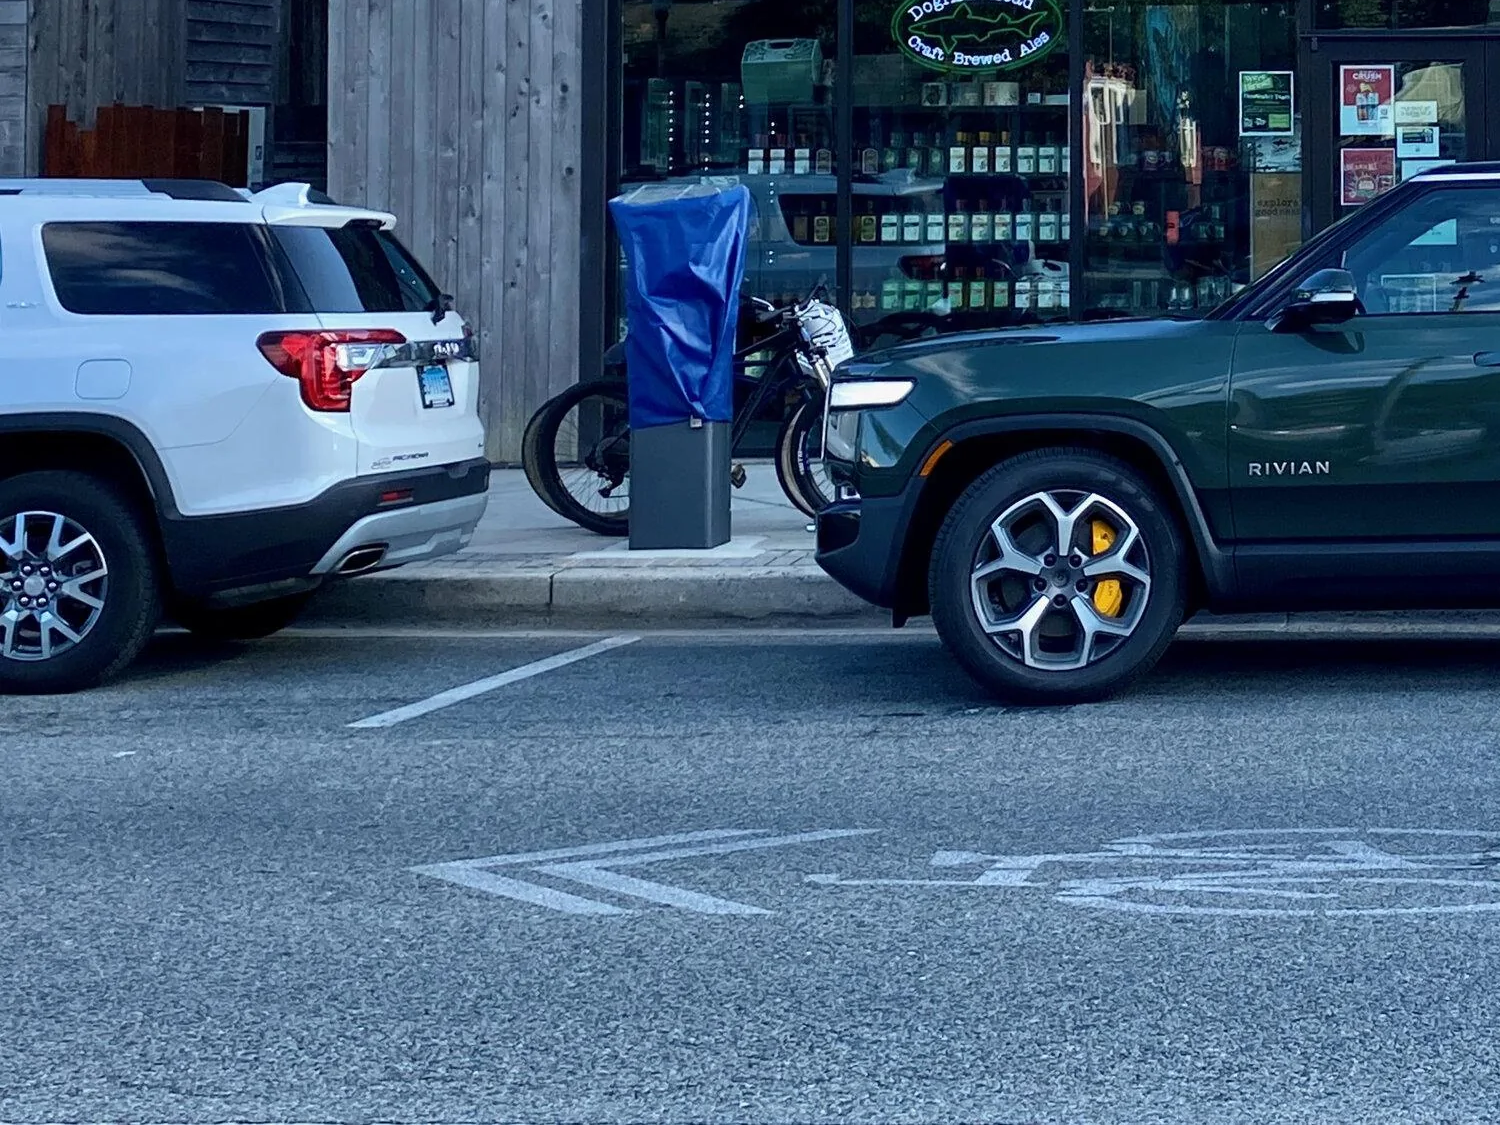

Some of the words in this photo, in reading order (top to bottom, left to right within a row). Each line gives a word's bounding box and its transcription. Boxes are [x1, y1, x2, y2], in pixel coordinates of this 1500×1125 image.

[908, 35, 944, 61] Craft
[952, 48, 1012, 65] Brewed
[1019, 31, 1050, 57] Ales
[1248, 461, 1330, 476] RIVIAN
